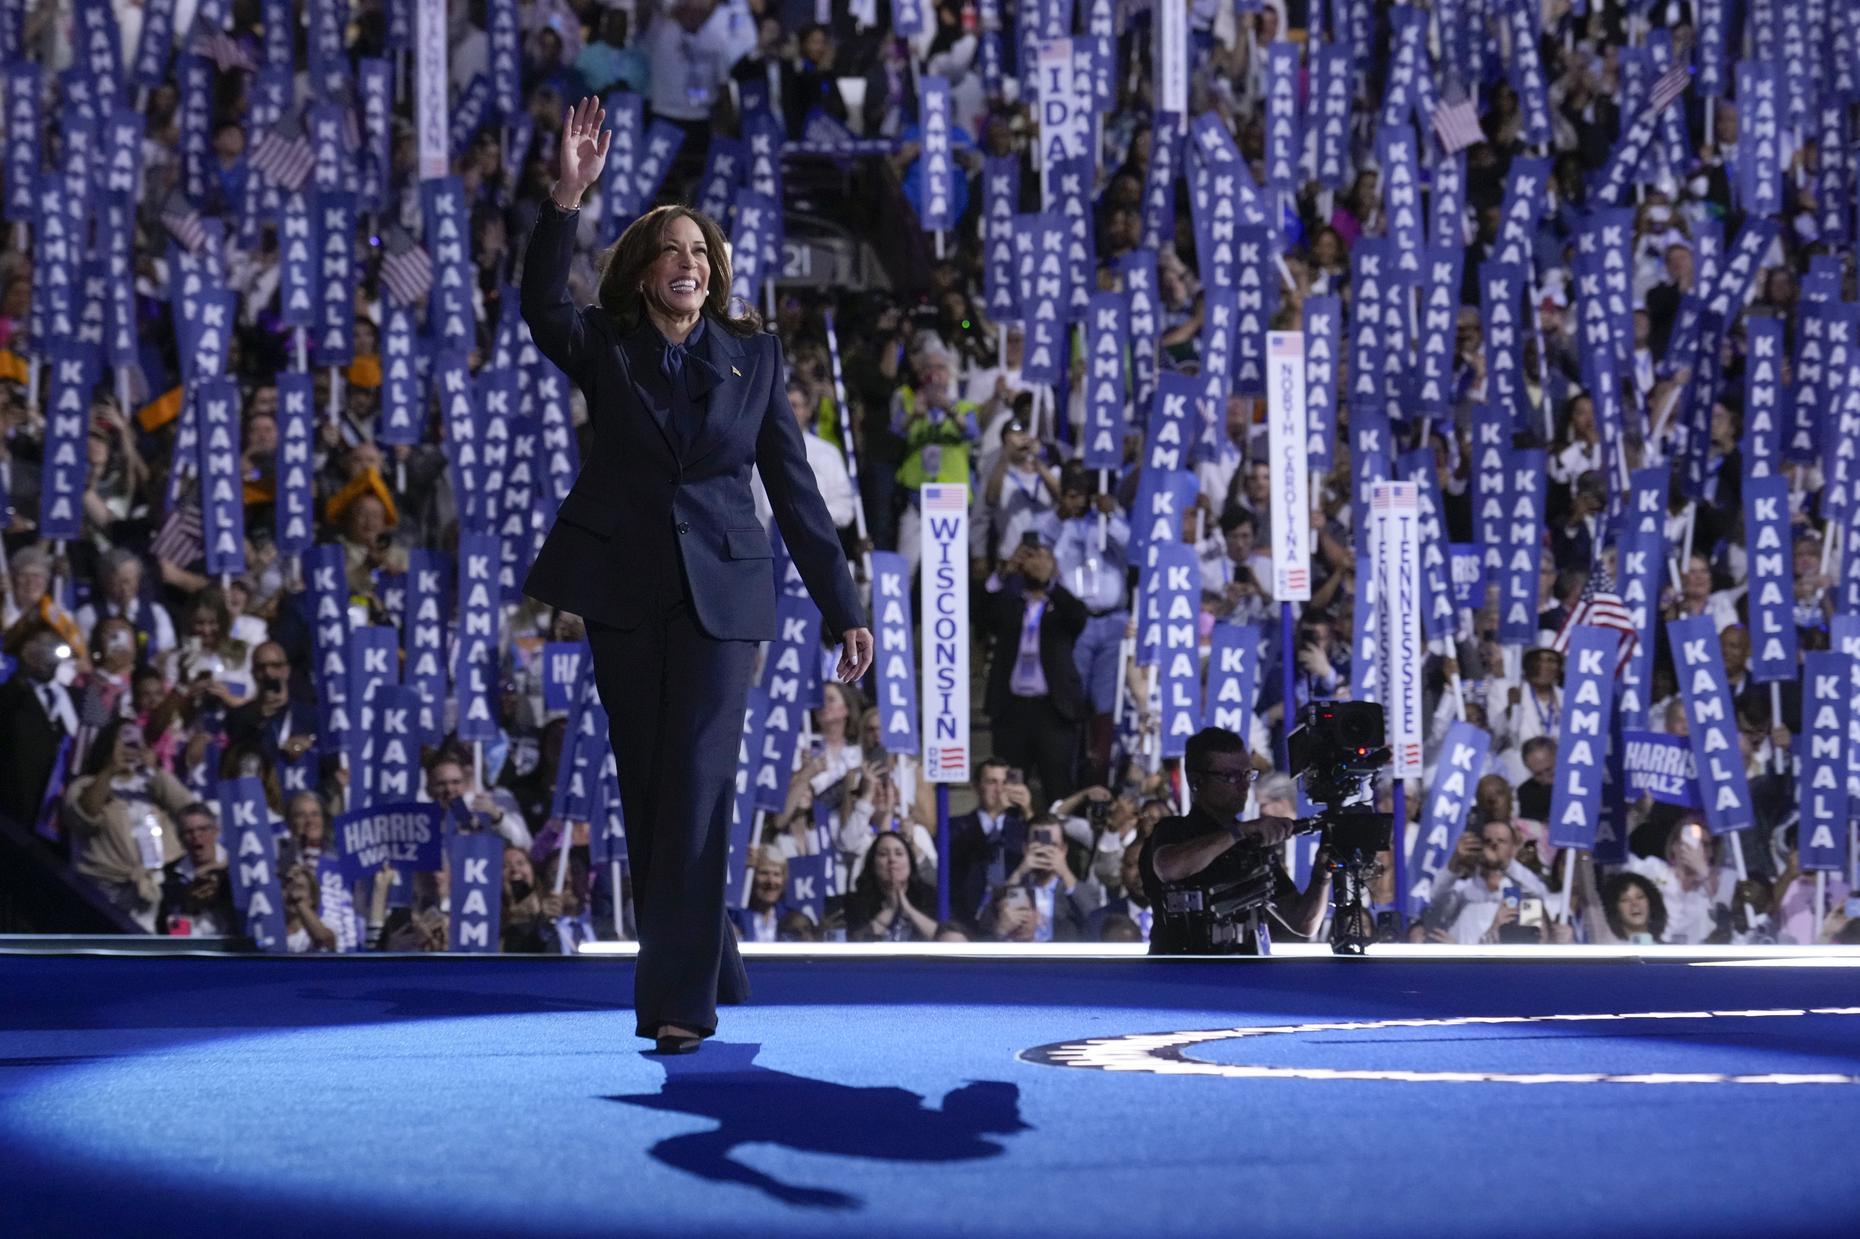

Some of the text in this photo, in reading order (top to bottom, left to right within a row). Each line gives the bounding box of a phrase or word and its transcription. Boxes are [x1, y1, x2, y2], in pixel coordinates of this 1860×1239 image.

[1272, 57, 1294, 178] KAMALA
[1322, 58, 1347, 175] KAMALA
[1387, 25, 1419, 126] KAMAL
[1513, 10, 1547, 128] KAMALA
[1783, 5, 1806, 113] KAMALA
[12, 77, 34, 206] KAMALA
[108, 127, 134, 191] KAM
[187, 68, 209, 195] KAMALA
[316, 121, 338, 184] KAM
[610, 108, 634, 214] KAMAL
[926, 91, 948, 215] KAMALA
[1754, 80, 1777, 199] KAMALA
[1821, 109, 1843, 230] KAMALA
[41, 191, 71, 334] KAMALA
[285, 193, 310, 310] AMALA
[435, 194, 465, 336] KAMALA
[731, 208, 760, 297] KAMA
[991, 175, 1013, 307] KAMALA
[1213, 175, 1236, 287] KAMAL
[1388, 142, 1419, 270] KAMALA
[1501, 176, 1537, 264] KAMA
[78, 277, 105, 343] KAM
[323, 208, 349, 349] KAMALA
[1031, 230, 1063, 367] KAMALA
[1238, 243, 1262, 380] KAMALA
[1356, 255, 1381, 394] KAMALA
[1421, 262, 1452, 401] KAMALA
[1580, 274, 1609, 344] KAM
[1709, 231, 1764, 315] KAMA
[195, 303, 225, 376] KAM
[387, 308, 410, 427] AMALA
[1094, 308, 1119, 452] KAMALA
[1281, 364, 1295, 435] NORTH
[1307, 314, 1331, 454] KAMALA
[1791, 317, 1822, 450] KAMALA
[50, 360, 83, 520] KAMALA
[206, 400, 237, 555] KAMALA
[284, 391, 307, 538] KAMALA
[537, 377, 572, 499] KAMAL
[1151, 394, 1186, 471] KAM
[1480, 423, 1505, 567] KAMALA
[1283, 446, 1299, 562] CAROLINA
[1508, 470, 1536, 625] KAMALA
[466, 555, 491, 721] KAMALA
[930, 516, 960, 740] WISCONSIN
[1398, 516, 1414, 735] TENNESSEE
[1755, 497, 1787, 661] KAMALA
[313, 566, 351, 732] KAMALA
[756, 618, 807, 789] KAMALA
[881, 572, 910, 734] KAMALA
[1167, 566, 1194, 736] KAMALA
[1215, 648, 1245, 732] KAM
[1561, 648, 1605, 826] KAMALA
[1631, 771, 1686, 796] WALZ
[1683, 638, 1741, 812] KAMALA
[1809, 675, 1842, 849] KAMALA
[233, 800, 276, 948] KAMAL
[343, 813, 432, 855] HARRIS
[1410, 743, 1477, 903] KAMALA
[460, 858, 488, 947] KAM
